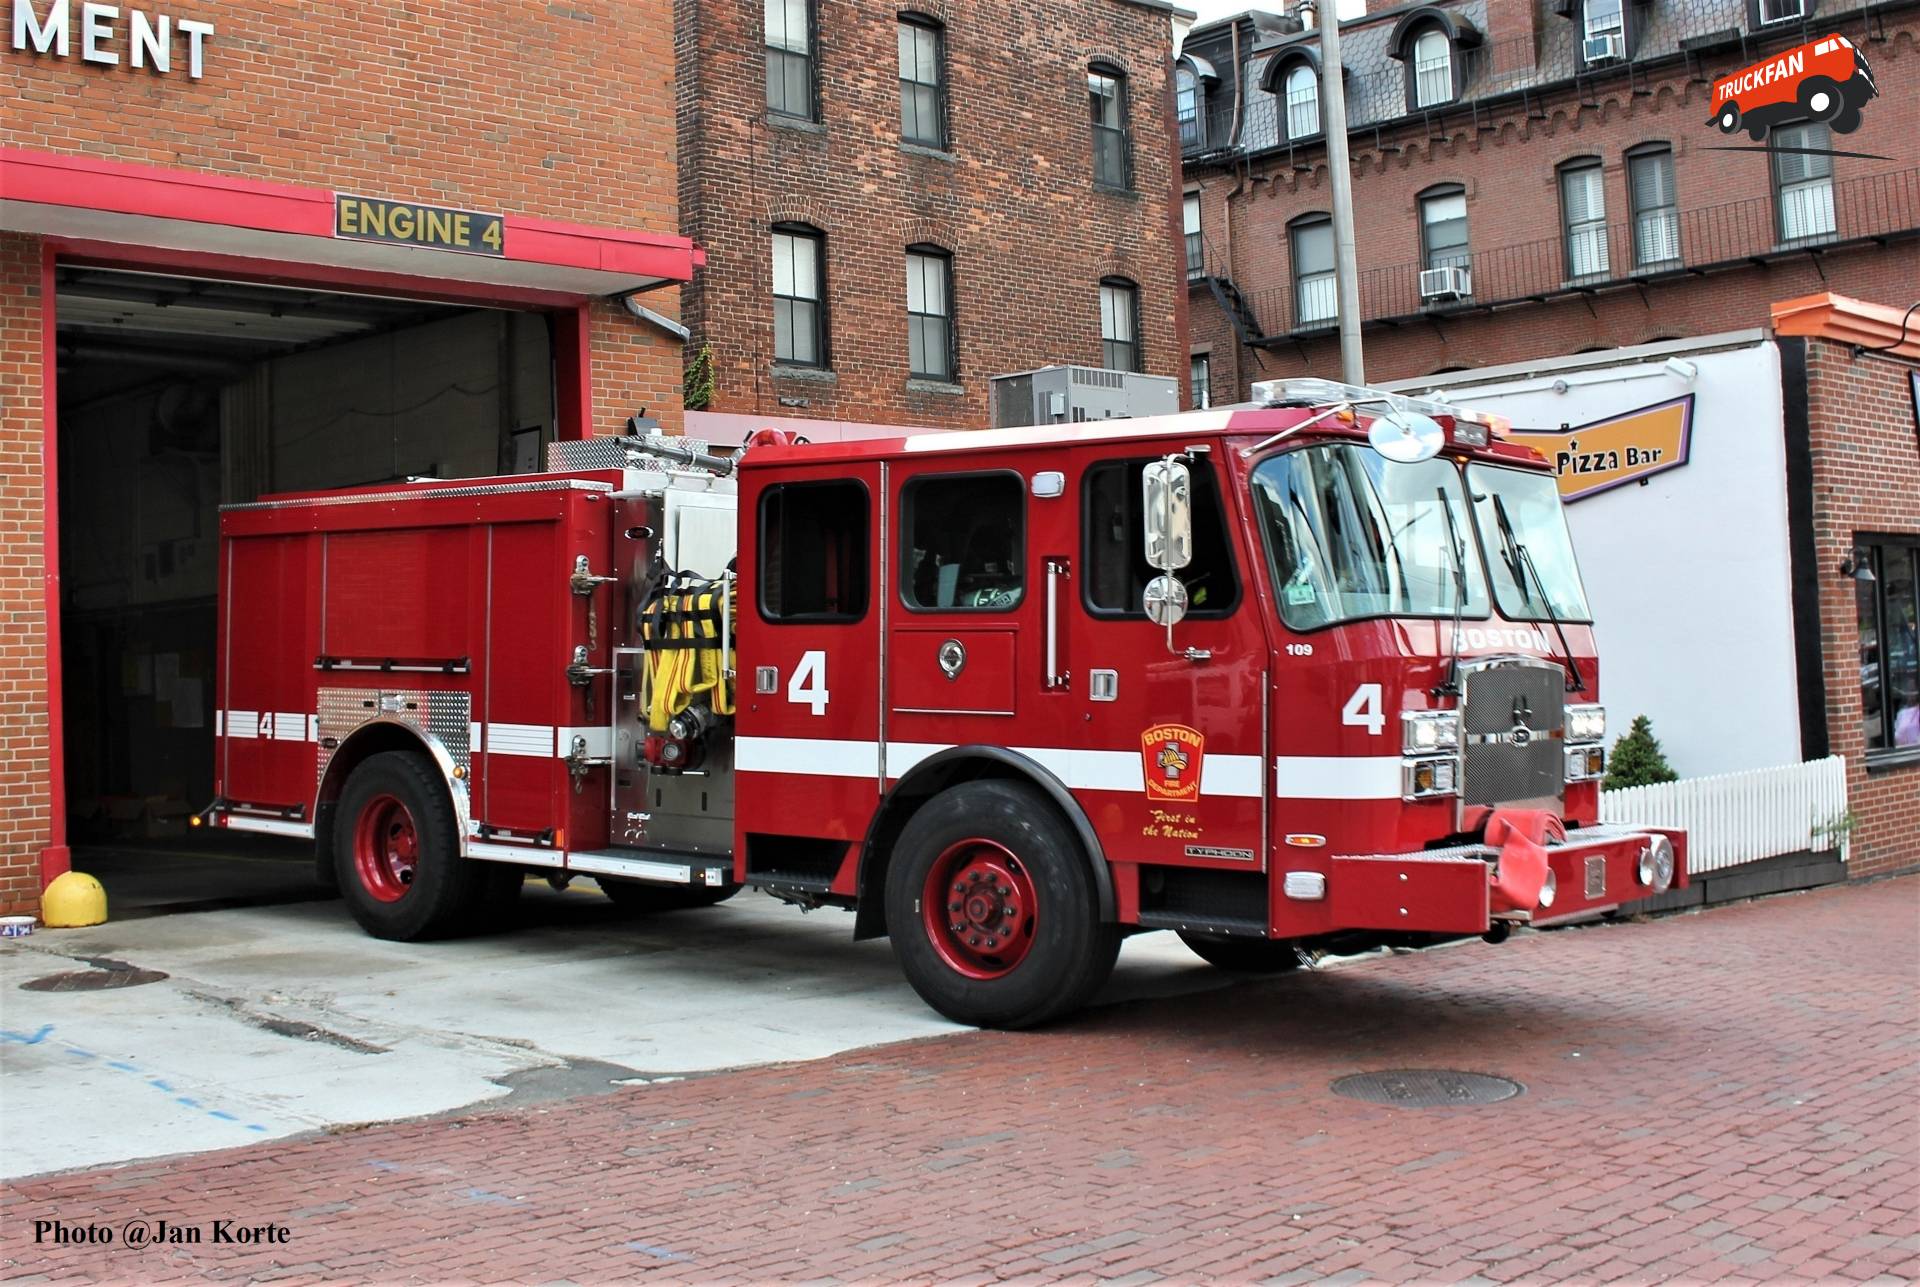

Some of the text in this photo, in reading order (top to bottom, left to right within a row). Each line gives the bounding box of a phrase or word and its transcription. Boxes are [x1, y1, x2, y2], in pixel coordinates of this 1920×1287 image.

[340, 199, 502, 250] ENGINE 4
[1556, 440, 1662, 475] Pizza Bar
[1285, 643, 1313, 656] 109
[1450, 628, 1551, 653] BOSTON
[787, 650, 829, 716] 4
[1342, 683, 1386, 735] 4
[258, 711, 274, 740] 4
[1144, 728, 1201, 748] BOSTON
[1148, 778, 1197, 797] DEPARTMENT
[1187, 848, 1253, 858] TYPHOON
